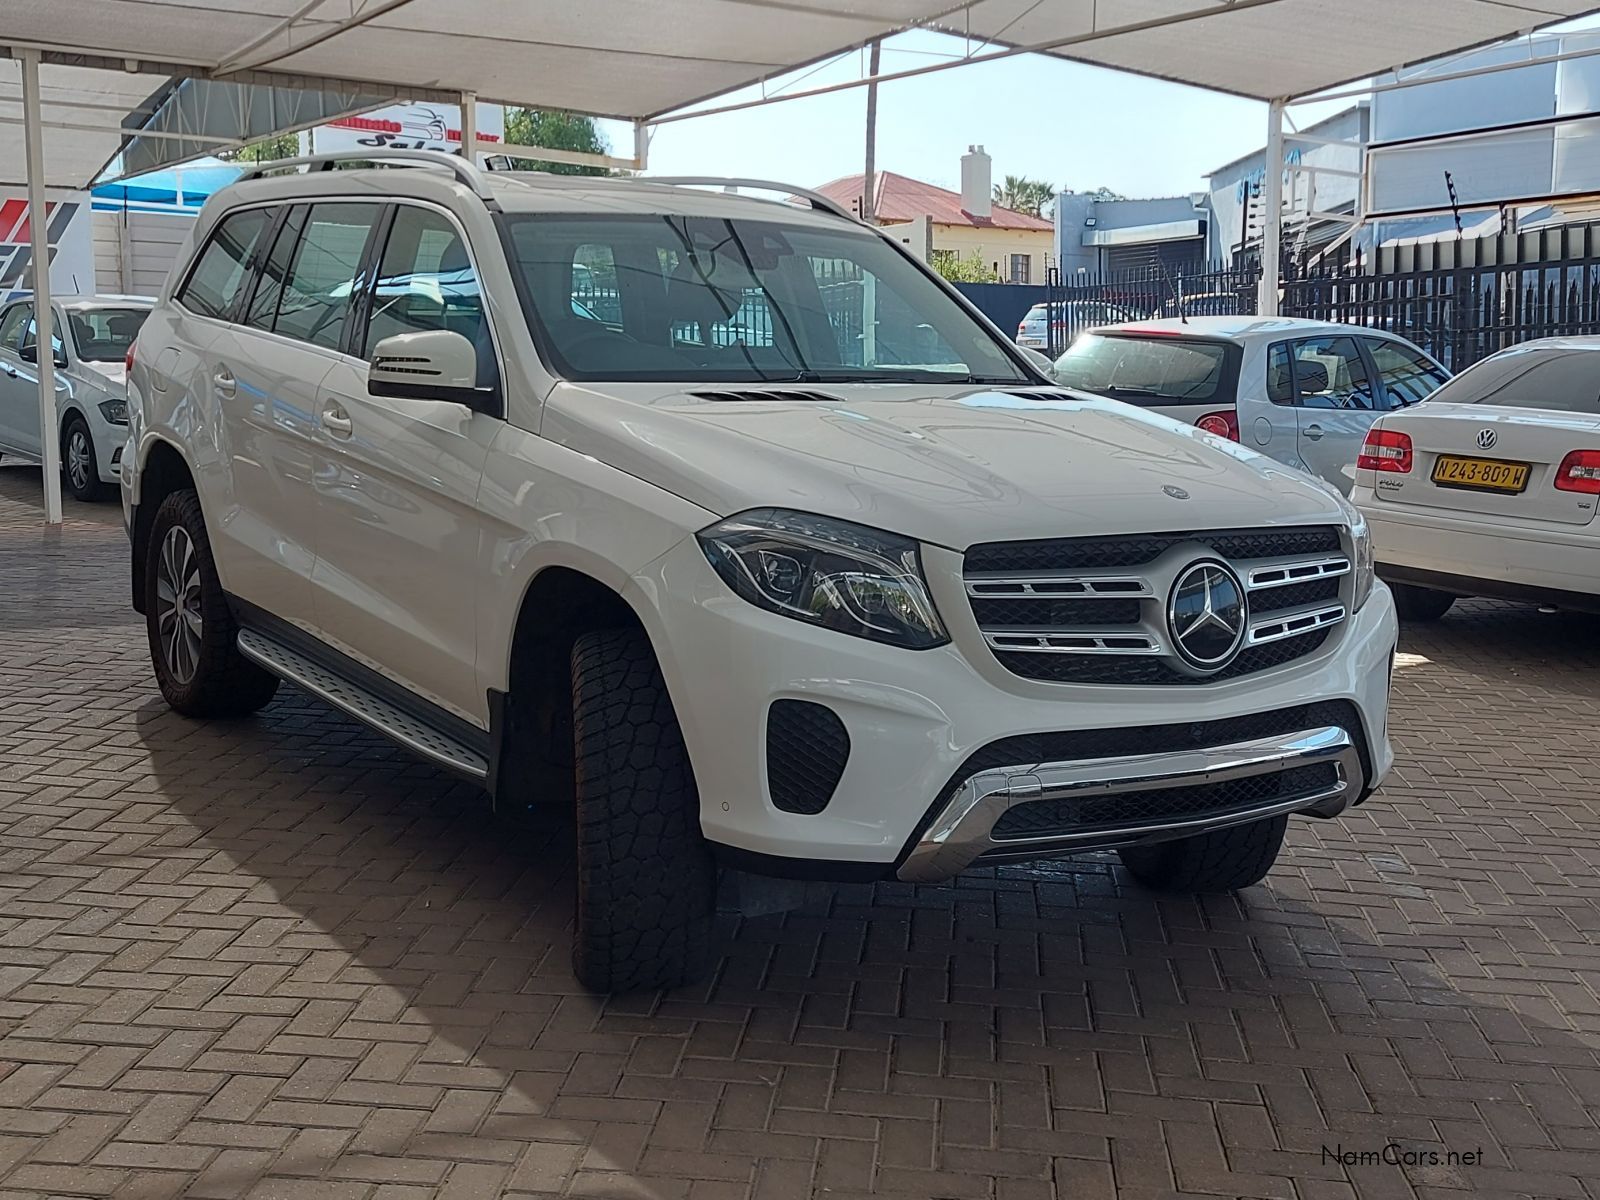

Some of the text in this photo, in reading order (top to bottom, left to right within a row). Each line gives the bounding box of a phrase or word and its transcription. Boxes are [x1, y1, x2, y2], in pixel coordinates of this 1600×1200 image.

[357, 133, 462, 156] Sal
[1437, 460, 1449, 478] N
[1449, 462, 1511, 483] 243-809
